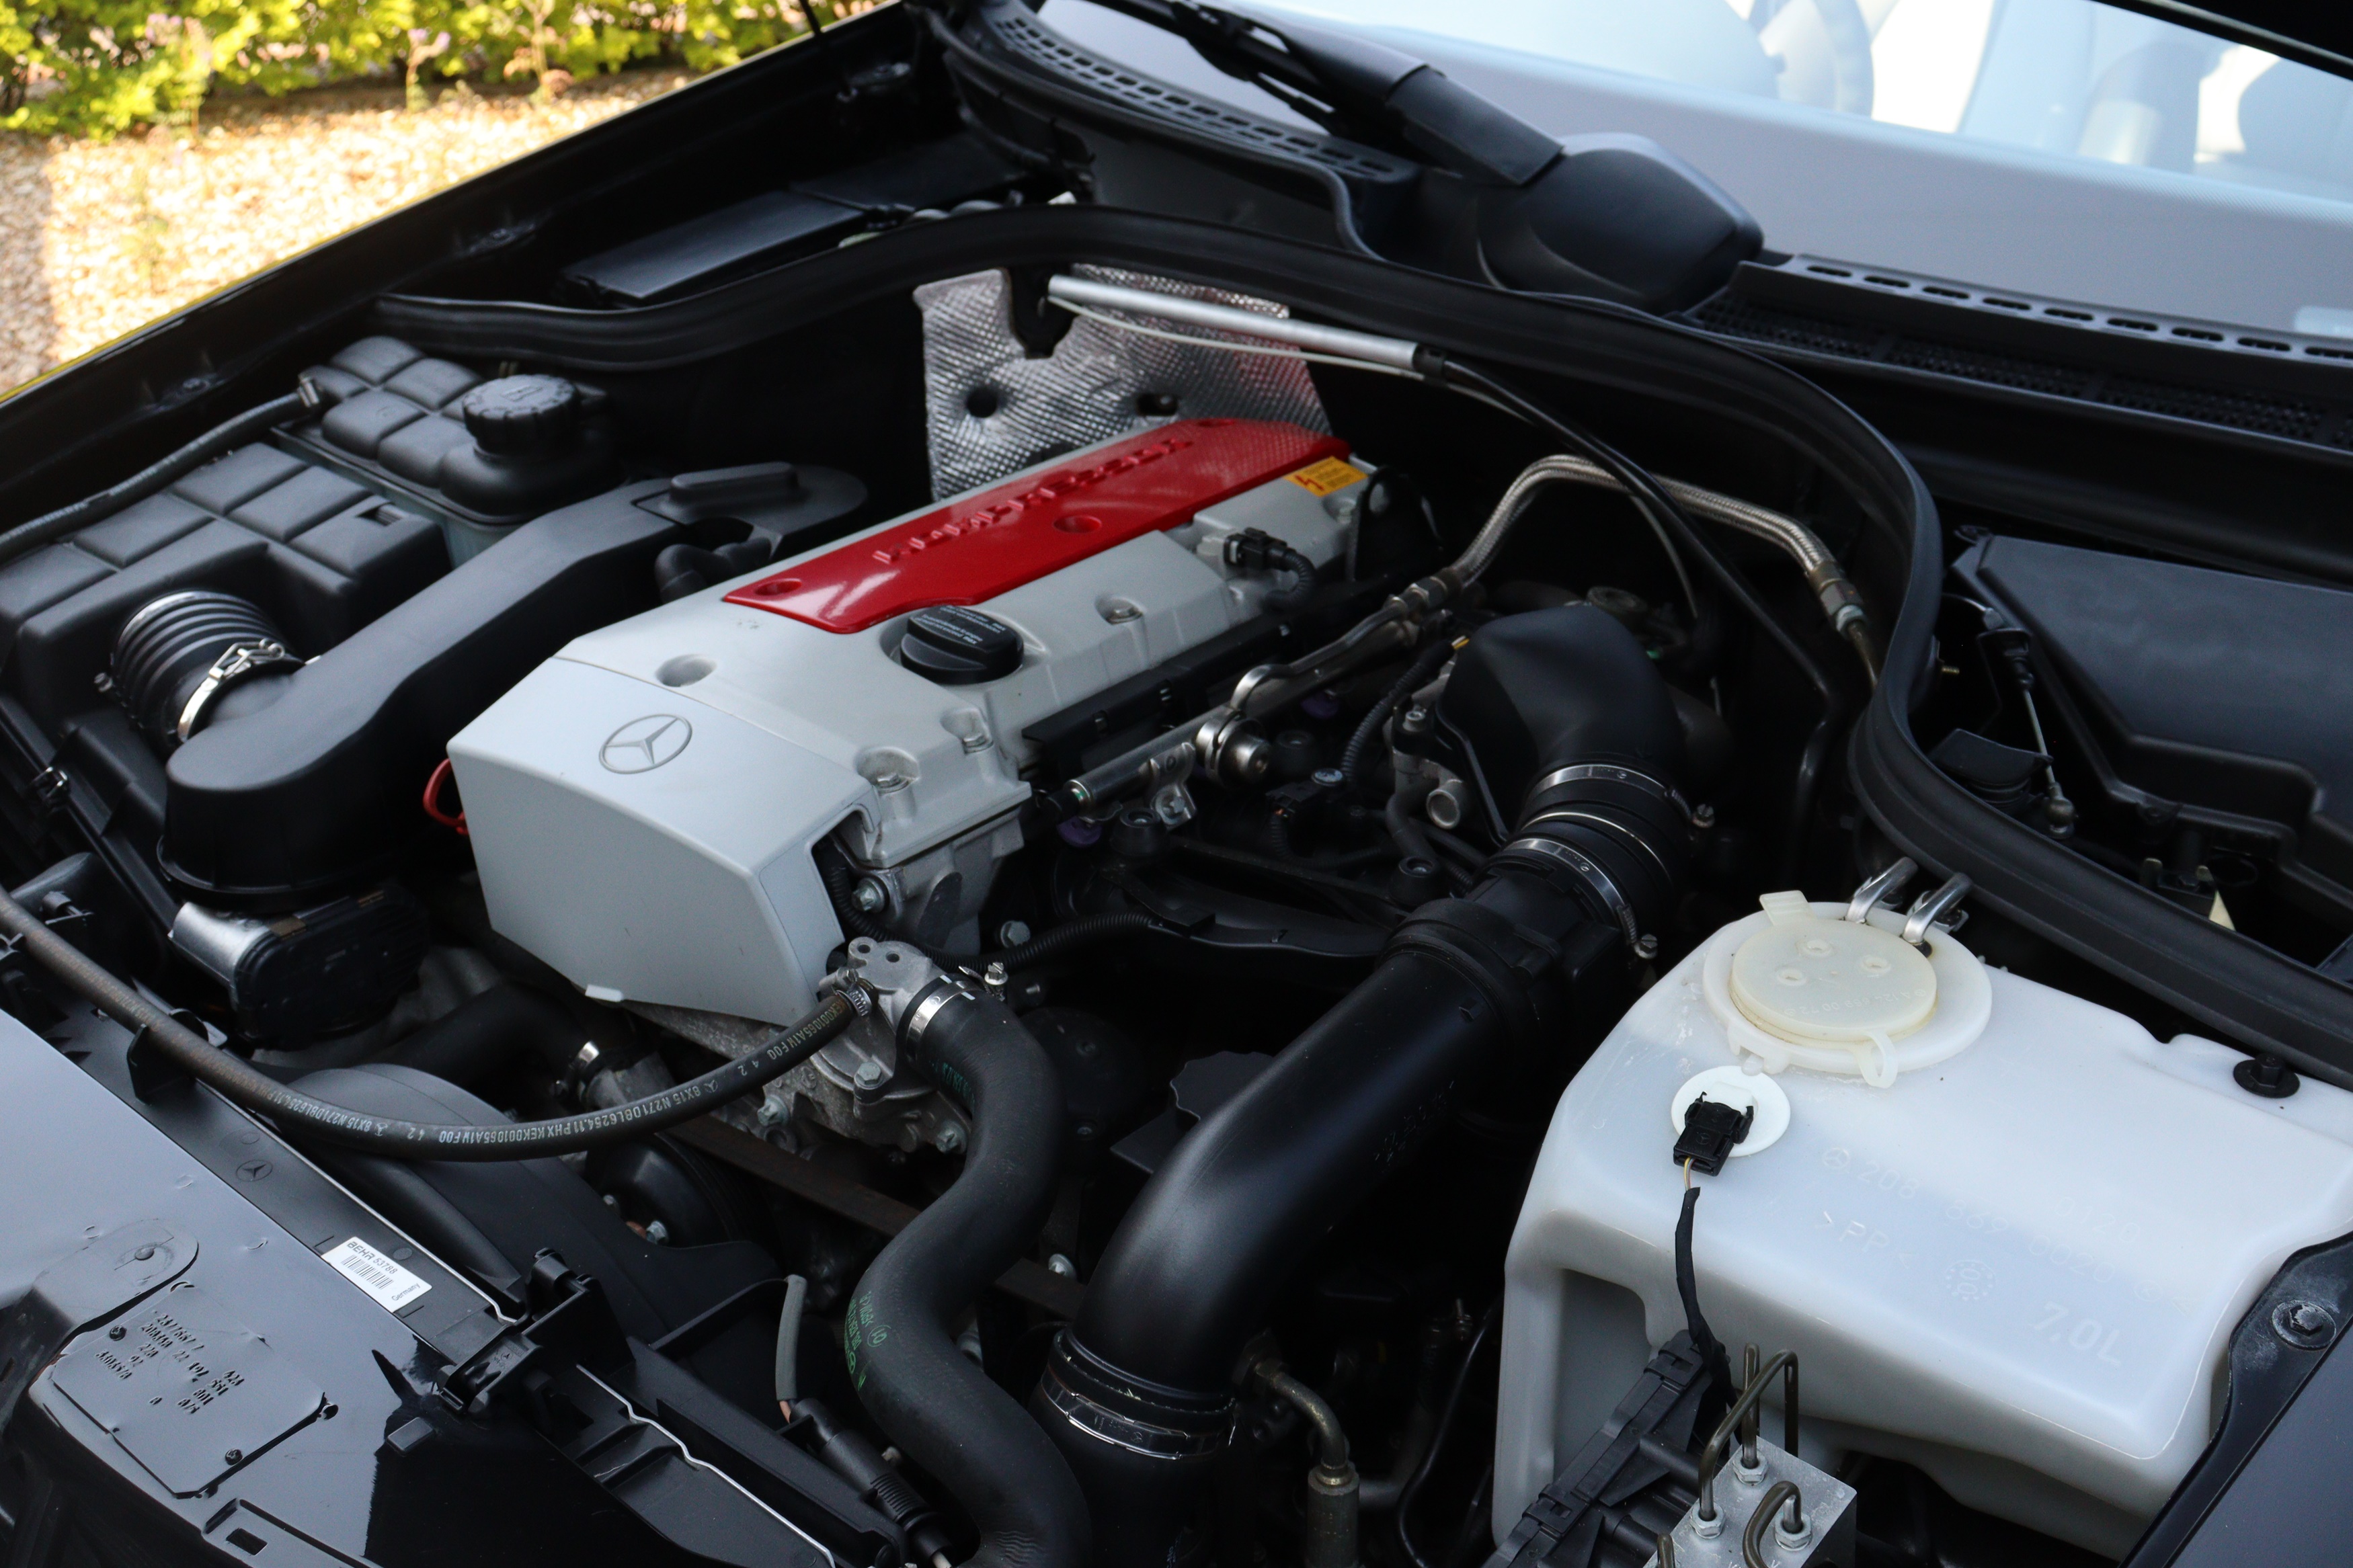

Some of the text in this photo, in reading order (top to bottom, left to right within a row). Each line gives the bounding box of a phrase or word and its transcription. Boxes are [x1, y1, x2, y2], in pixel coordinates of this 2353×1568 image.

[1821, 1001, 1840, 1012] 00
[672, 1085, 701, 1106] 8X15
[346, 1118, 372, 1132] 8X15
[547, 1122, 571, 1138] PHX
[1856, 1159, 2116, 1284] 208 869 0020
[2053, 1194, 2141, 1244] 0120
[346, 1241, 398, 1275] BEHR 53788
[391, 1282, 422, 1301] Germany
